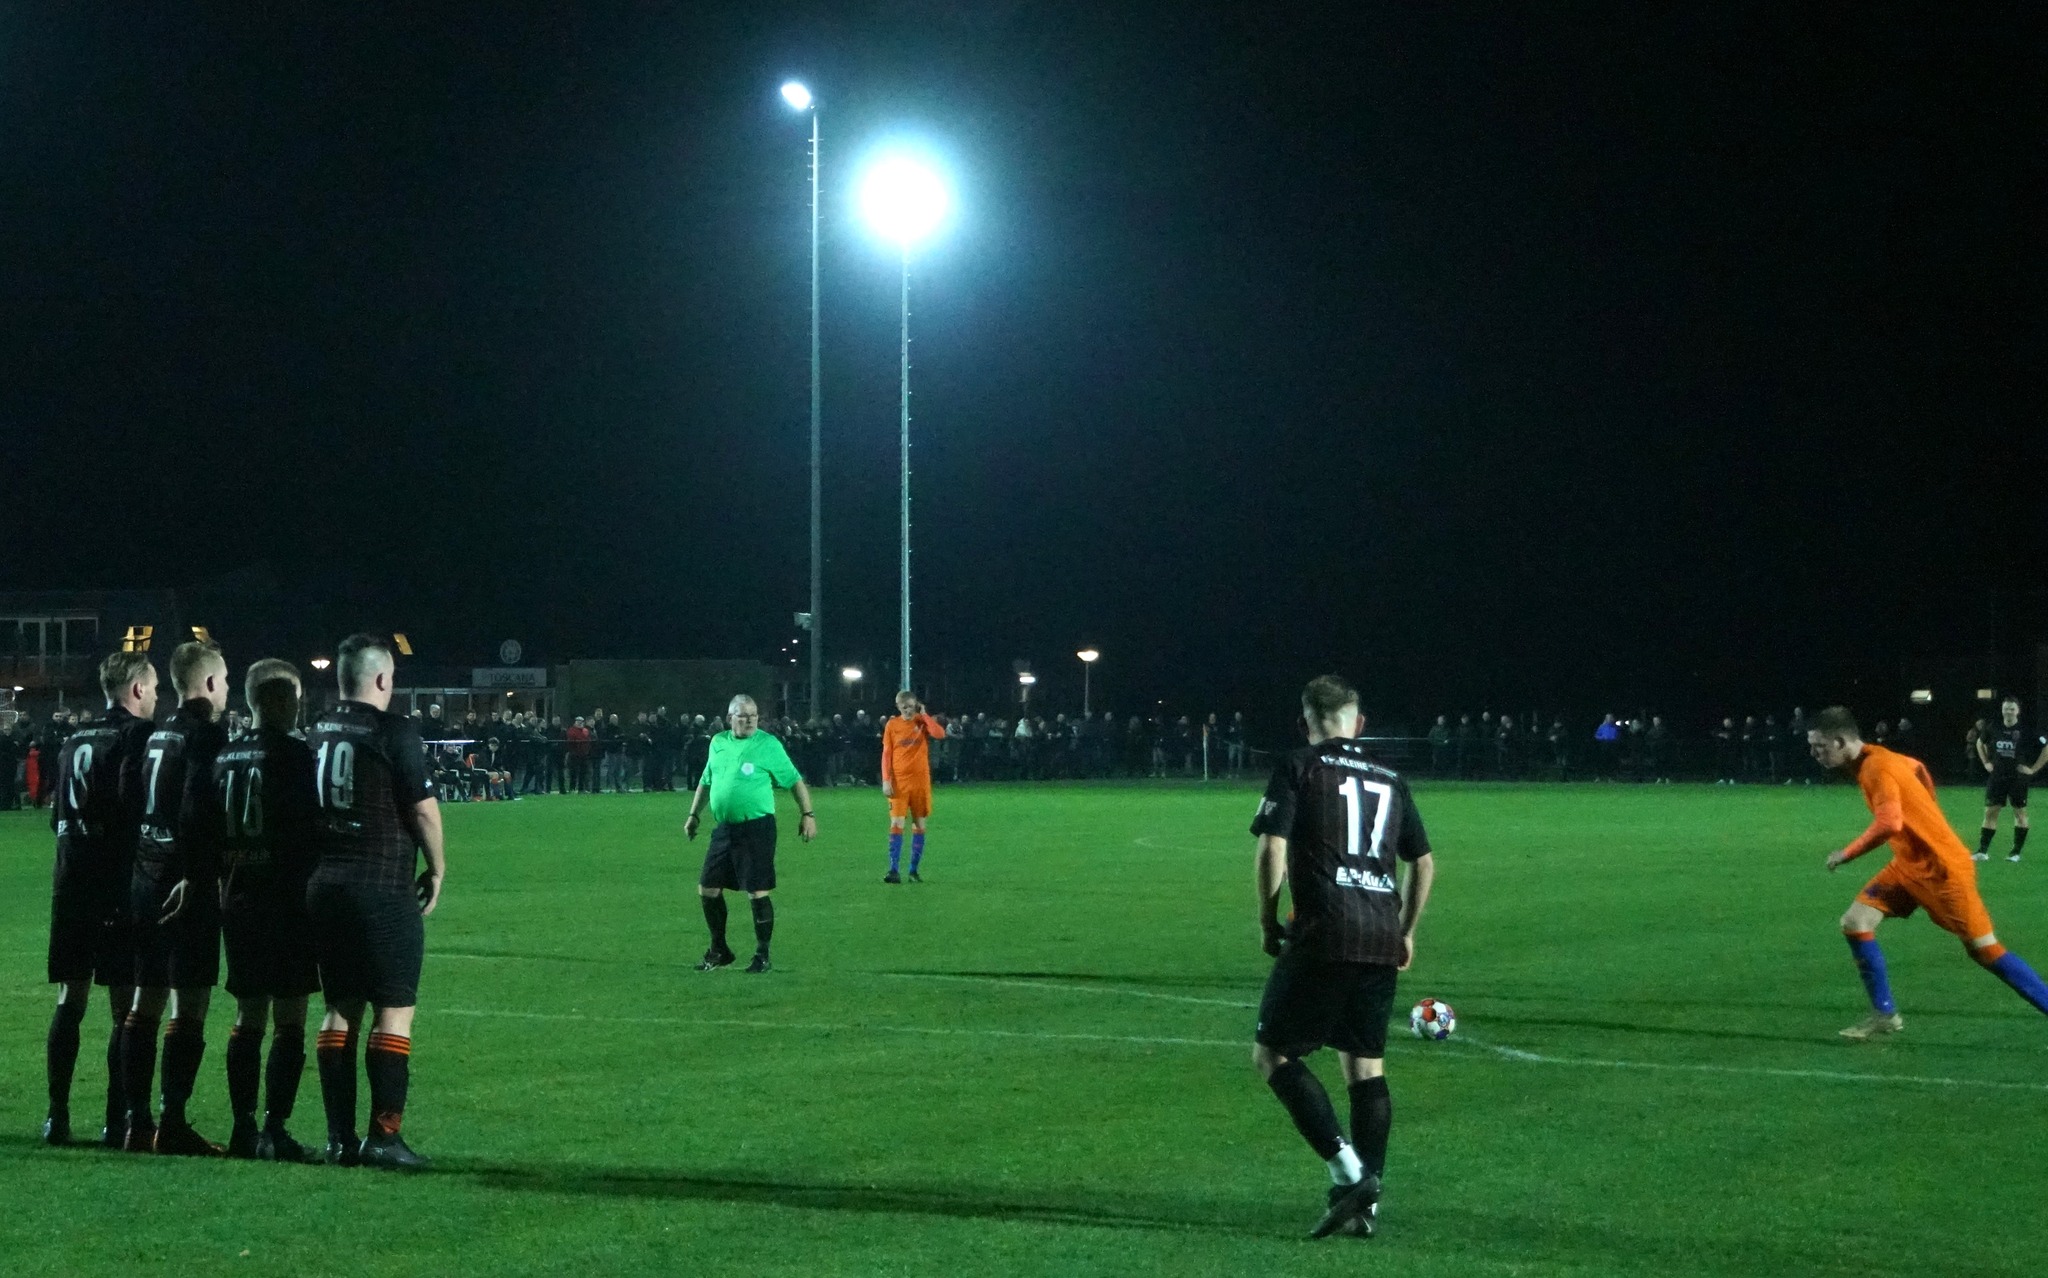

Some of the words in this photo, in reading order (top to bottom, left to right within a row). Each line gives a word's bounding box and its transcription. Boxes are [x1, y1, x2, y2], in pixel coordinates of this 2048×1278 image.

[146, 749, 164, 815] 7
[317, 741, 354, 809] 19
[1338, 776, 1392, 859] 17
